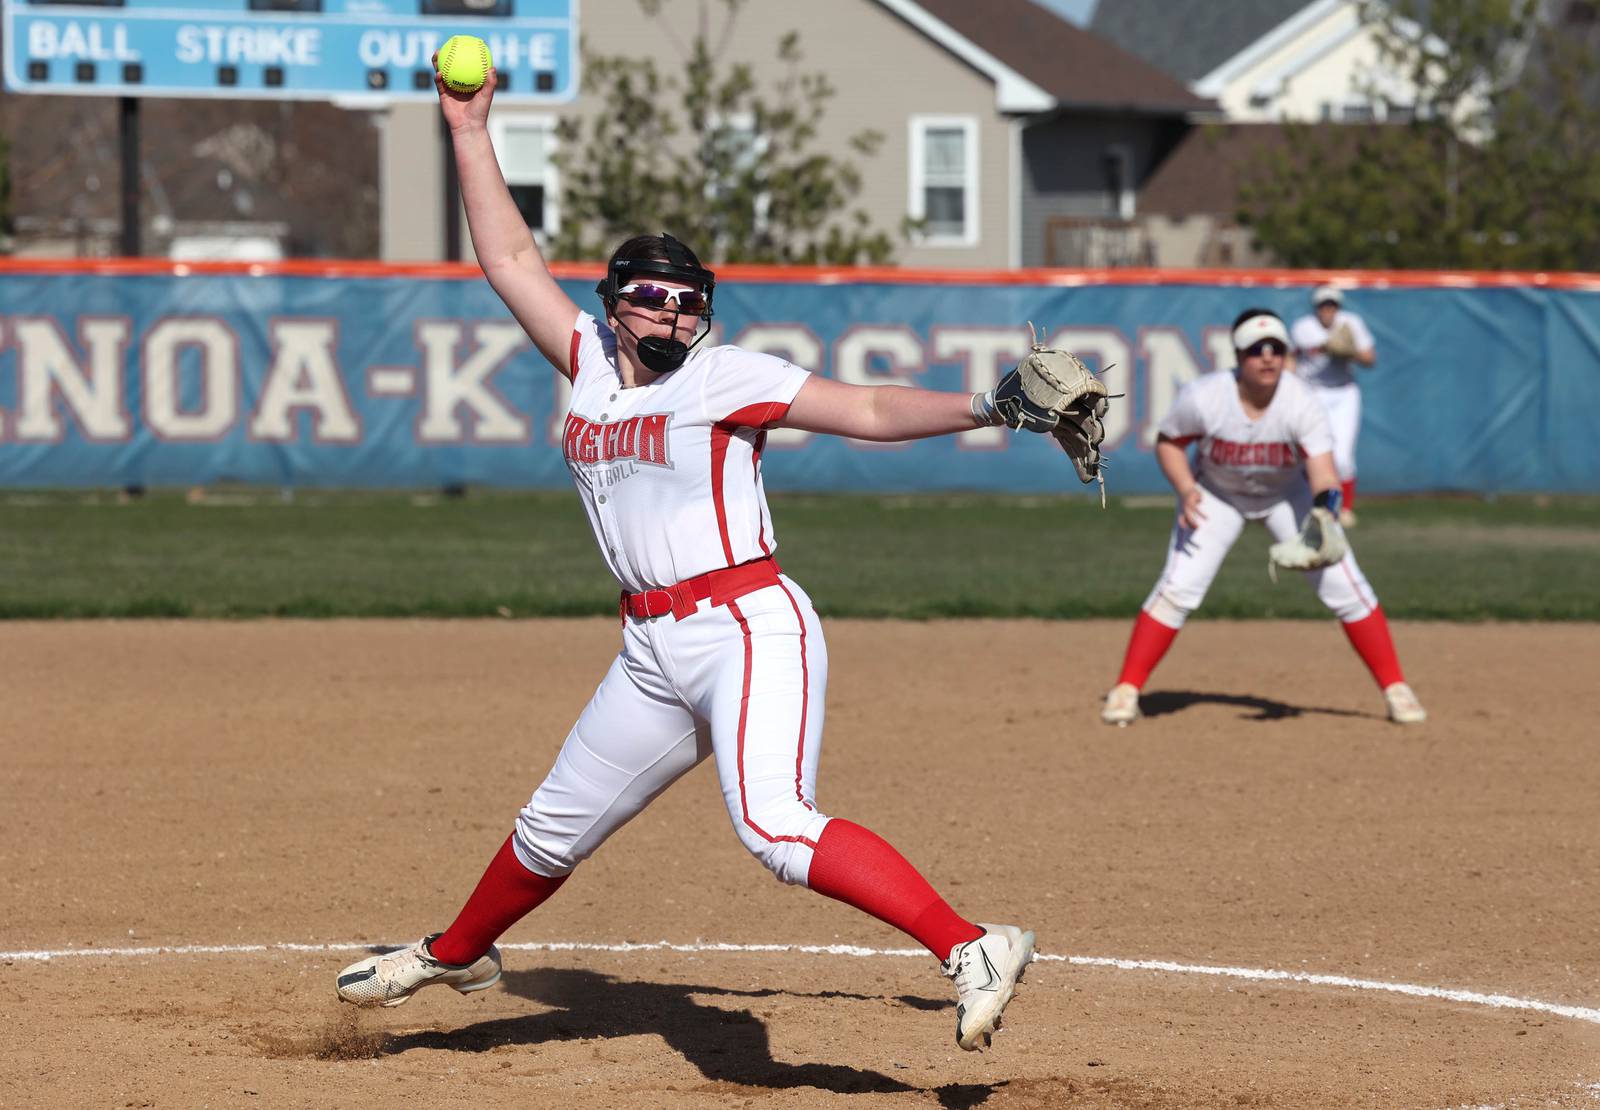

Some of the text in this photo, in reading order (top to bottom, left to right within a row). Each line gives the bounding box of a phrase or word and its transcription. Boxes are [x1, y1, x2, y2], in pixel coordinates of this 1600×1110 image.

[28, 22, 141, 60] BALL
[174, 26, 320, 65] STRIKE
[562, 410, 675, 469] REGON
[1210, 436, 1298, 468] OREGON
